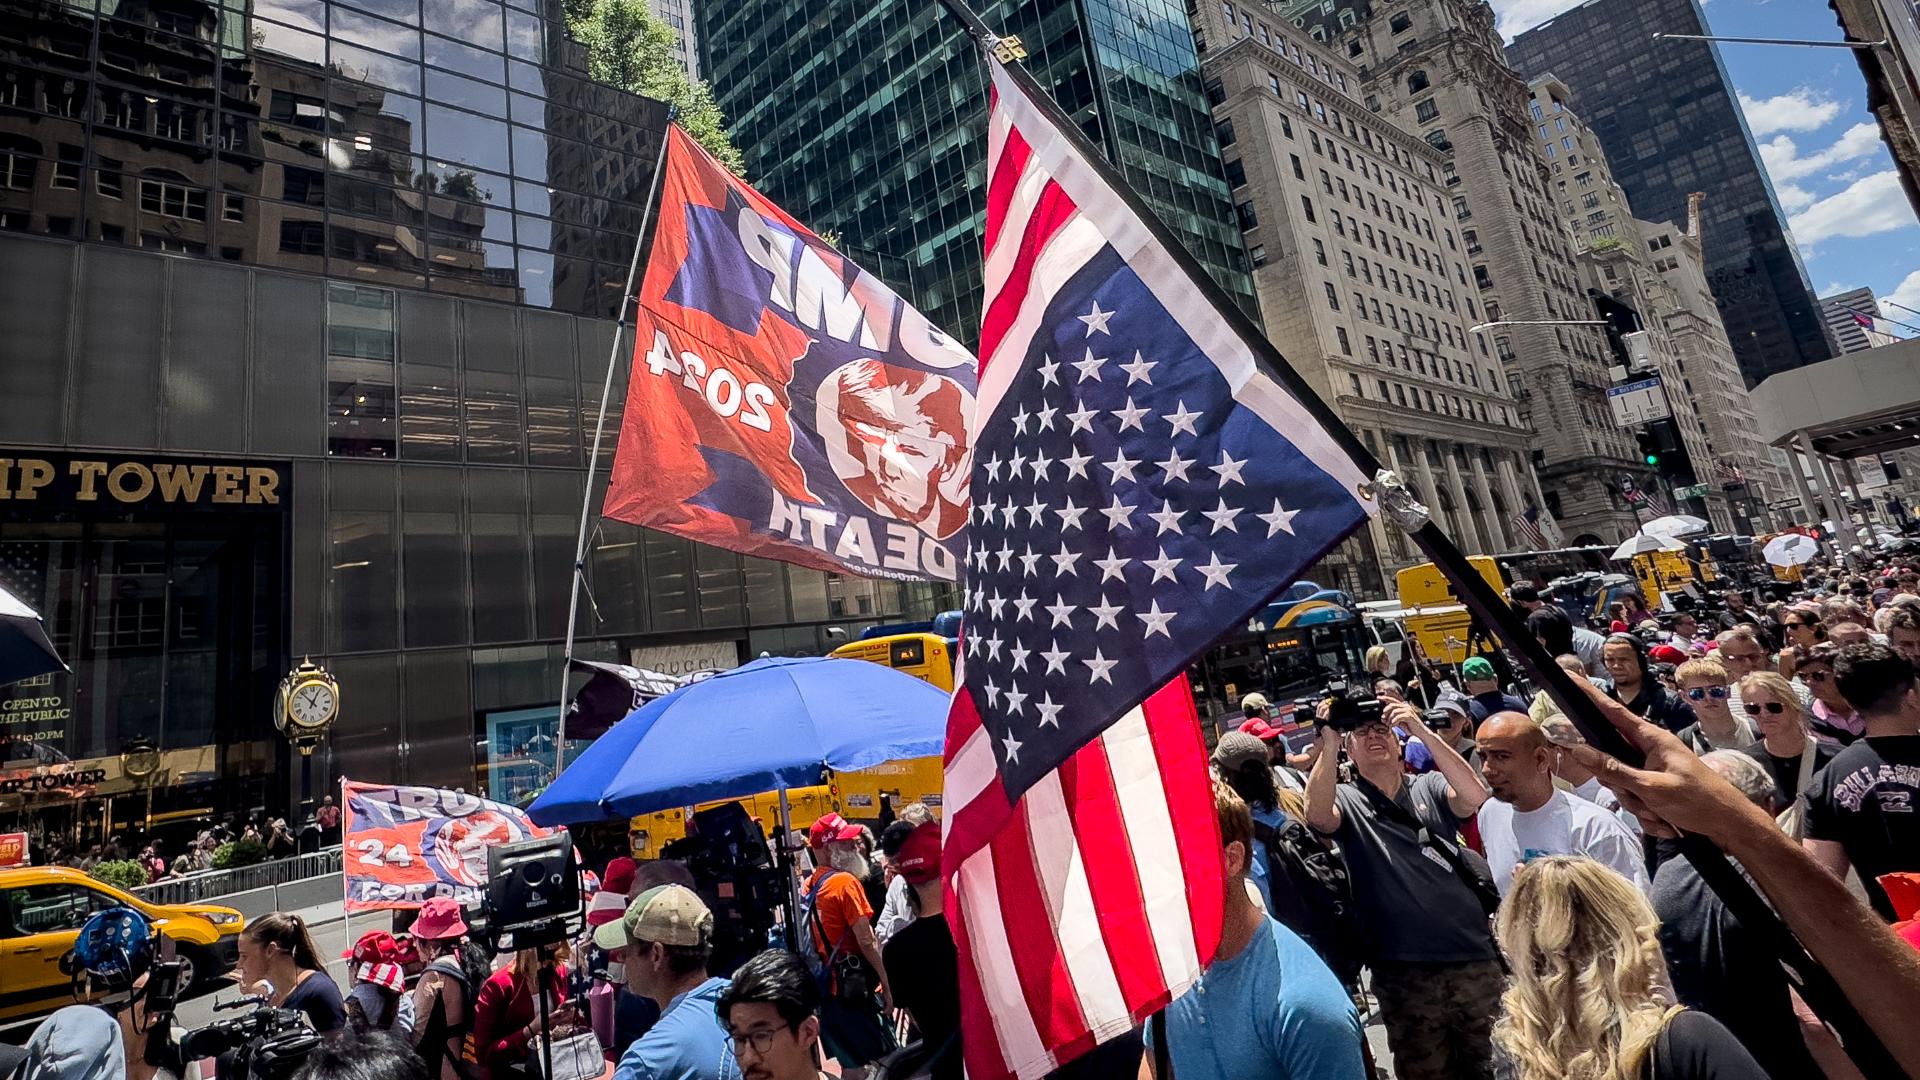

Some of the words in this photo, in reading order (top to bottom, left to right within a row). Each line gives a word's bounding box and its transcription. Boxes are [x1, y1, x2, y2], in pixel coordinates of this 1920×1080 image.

[69, 460, 280, 504] TOWER
[655, 657, 717, 676] GUCCI
[2, 698, 40, 711] OPEN
[41, 696, 62, 708] TO
[22, 708, 71, 722] PUBLIC
[47, 730, 65, 740] PM
[28, 769, 107, 791] TOWER
